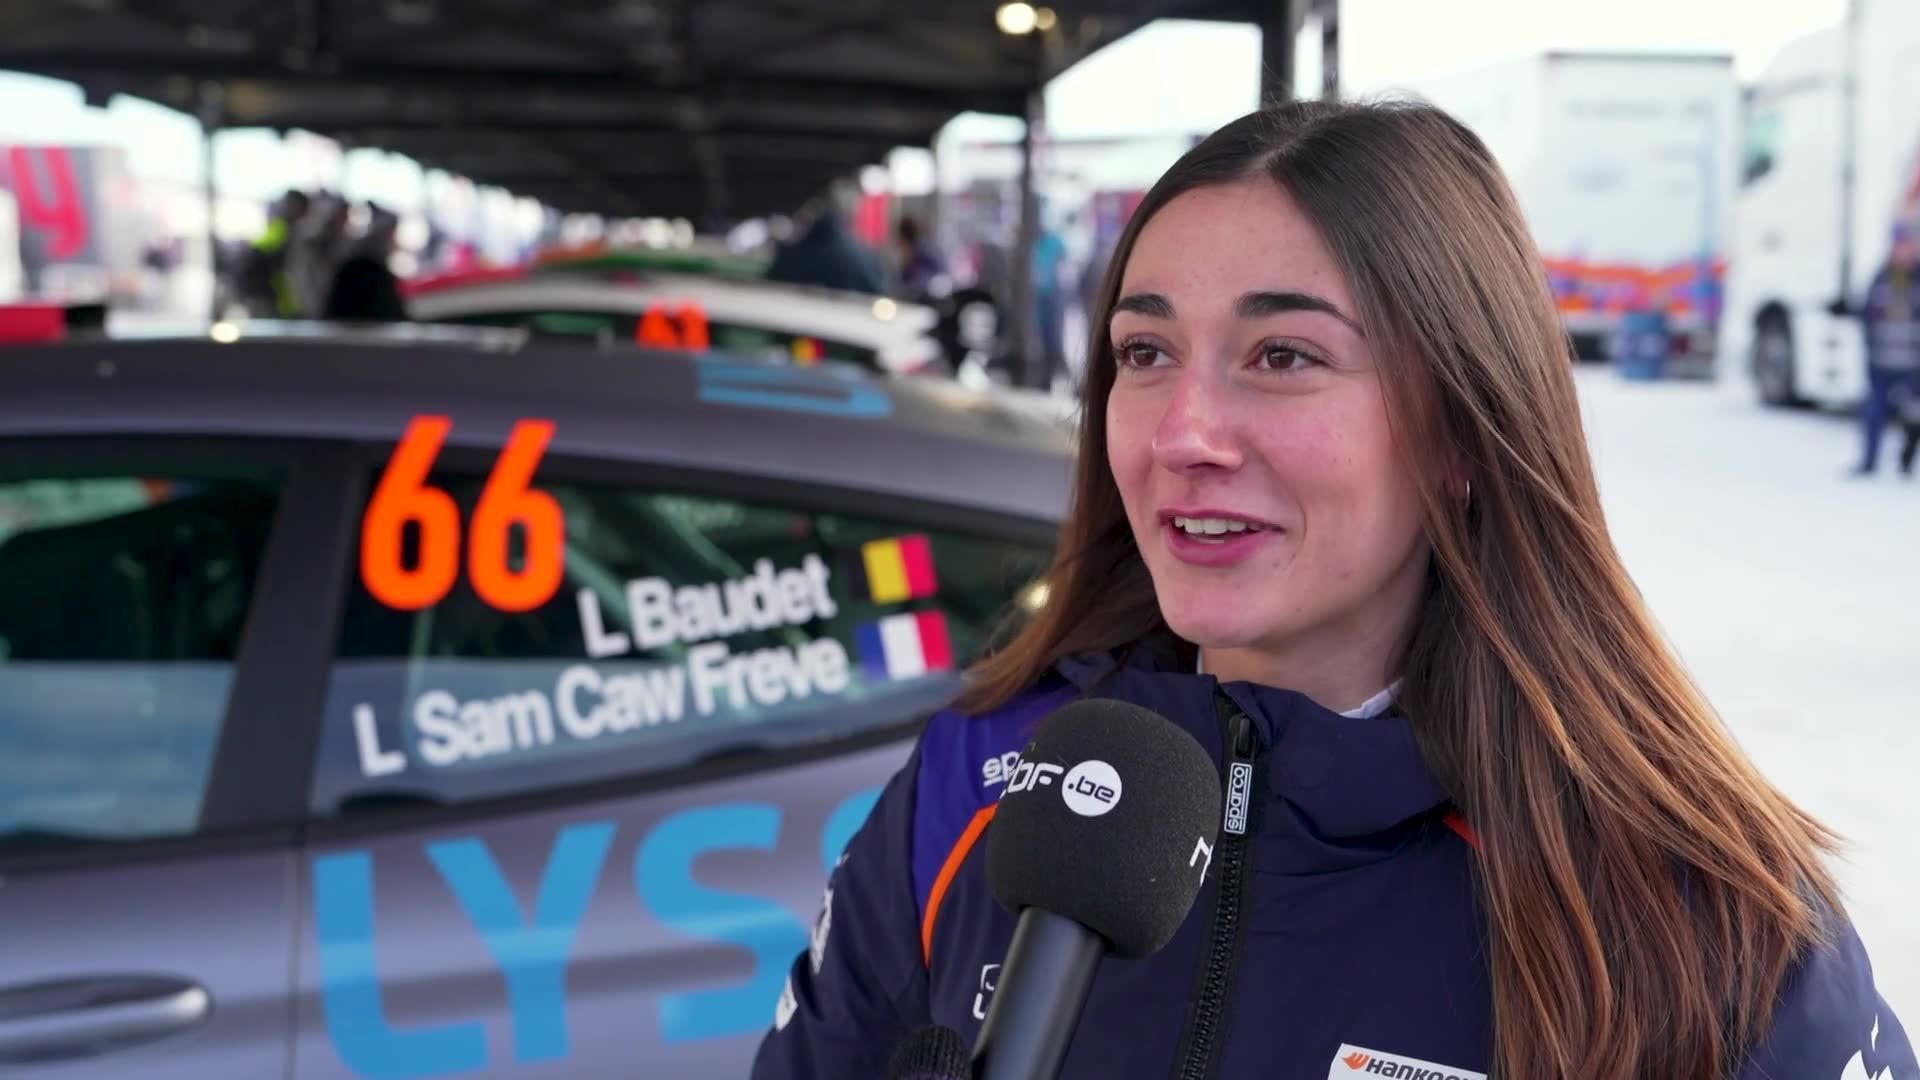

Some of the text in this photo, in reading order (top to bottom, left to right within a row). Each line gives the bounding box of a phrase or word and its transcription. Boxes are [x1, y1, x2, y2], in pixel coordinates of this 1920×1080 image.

[359, 414, 566, 612] 66
[576, 552, 837, 658] L Baudet
[352, 636, 851, 777] L Sam Caw Freve
[1228, 766, 1249, 831] sparco
